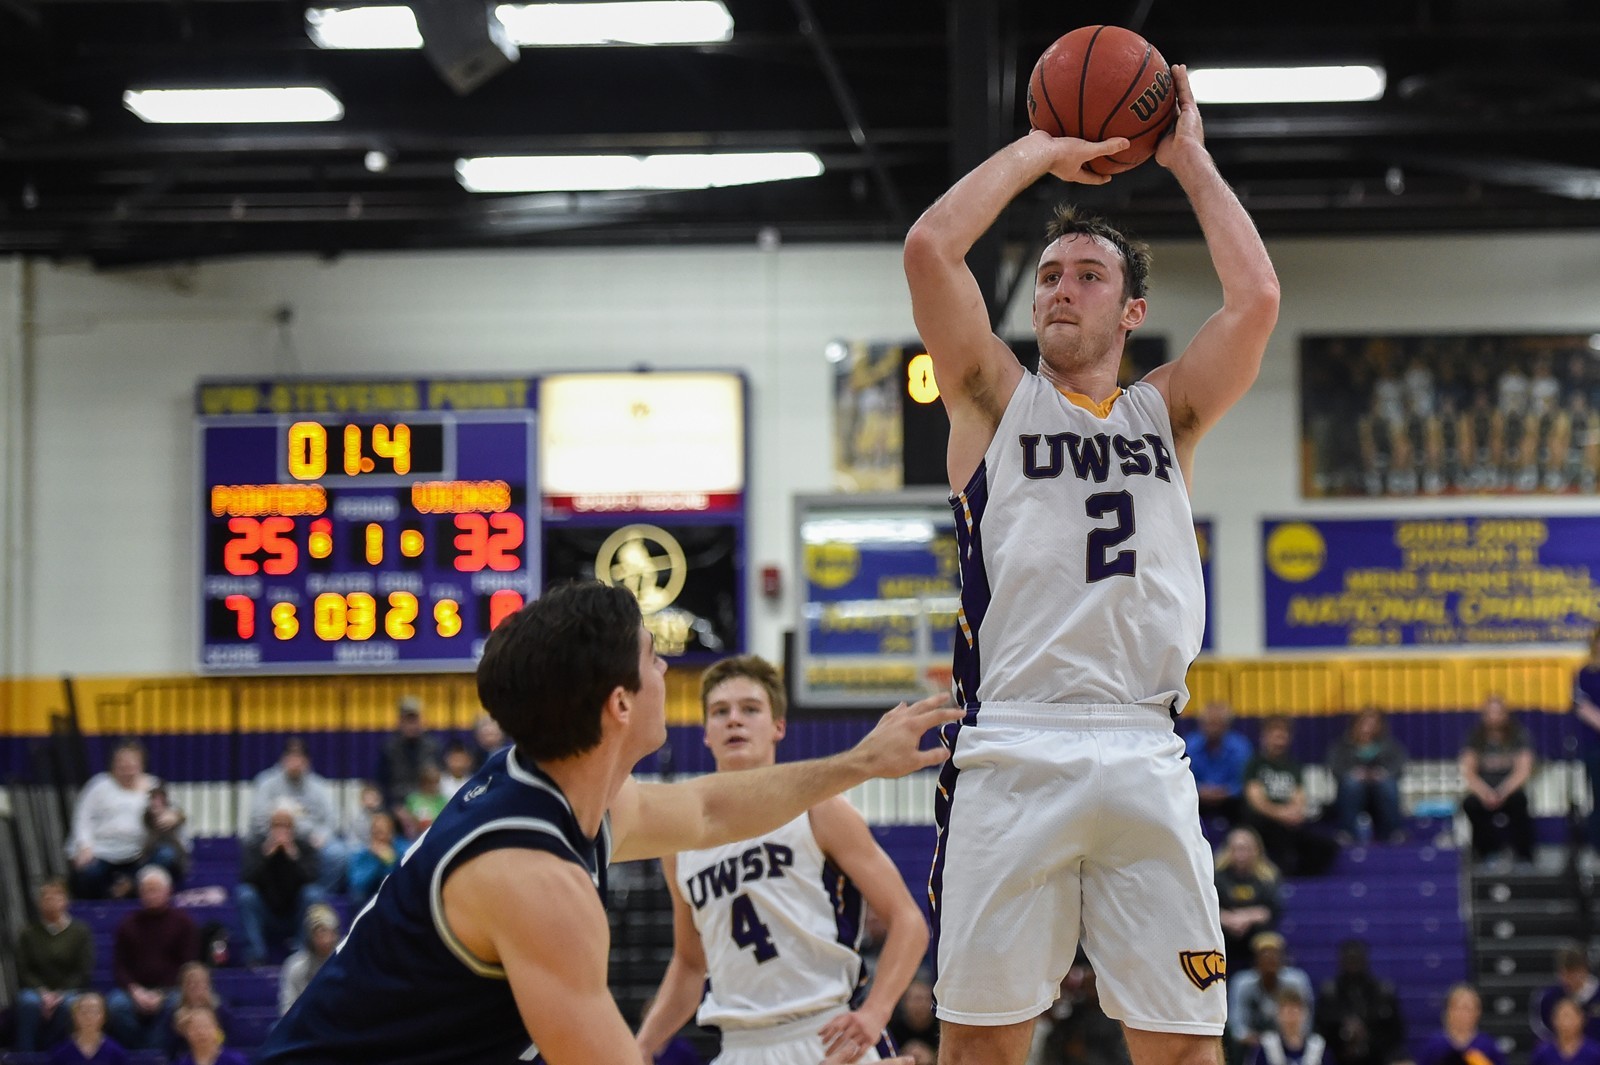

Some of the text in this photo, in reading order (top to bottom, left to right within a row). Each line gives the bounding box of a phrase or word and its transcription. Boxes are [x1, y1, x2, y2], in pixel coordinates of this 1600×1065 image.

[1019, 432, 1172, 483] UWSP
[224, 516, 298, 576] 25
[366, 523, 384, 565] 1
[454, 512, 524, 571] 32
[1085, 489, 1136, 583] 2
[225, 594, 255, 639] 7
[314, 592, 376, 640] 03
[385, 591, 419, 640] 2
[686, 842, 793, 911] UWSP
[731, 893, 779, 966] 4
